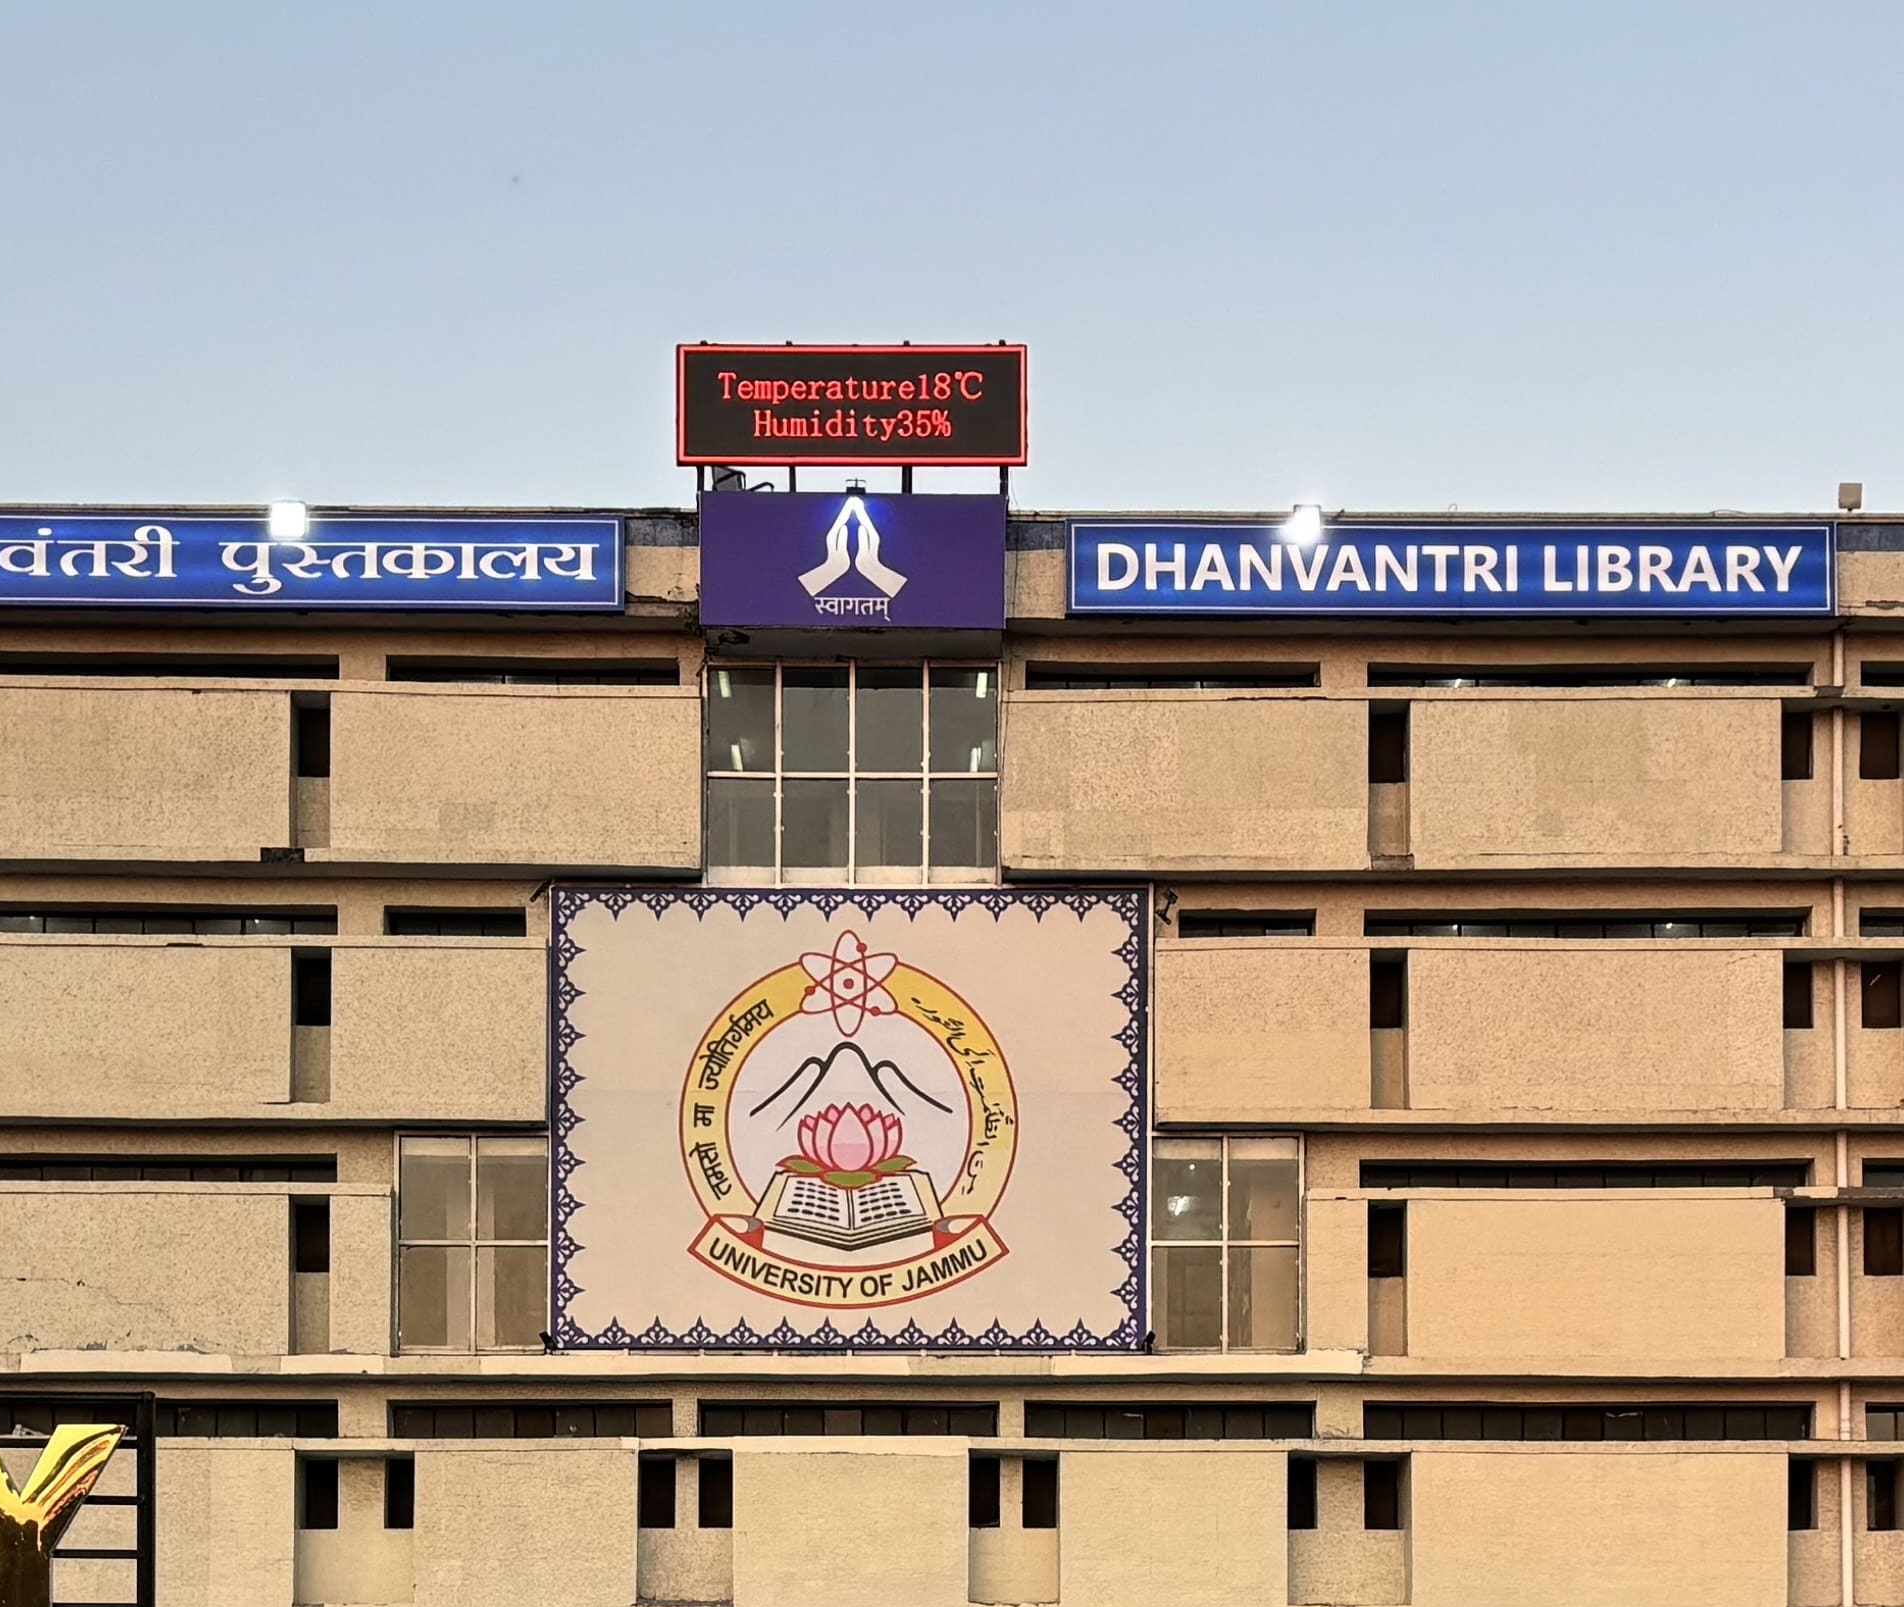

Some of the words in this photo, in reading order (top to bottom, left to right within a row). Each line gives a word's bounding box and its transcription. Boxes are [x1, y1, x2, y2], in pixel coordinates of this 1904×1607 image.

[752, 408, 952, 441] Humidity35%
[218, 540, 600, 596] पुस्तकालय
[1096, 543, 1518, 593] DHANVANTRI
[1545, 545, 1804, 594] LIBRARY
[813, 595, 892, 622] स्वागतम्
[693, 1102, 716, 1128] मा
[708, 1237, 854, 1299] UNIVERSITY
[859, 1273, 895, 1297] OF
[900, 1238, 989, 1294] JAMMU
